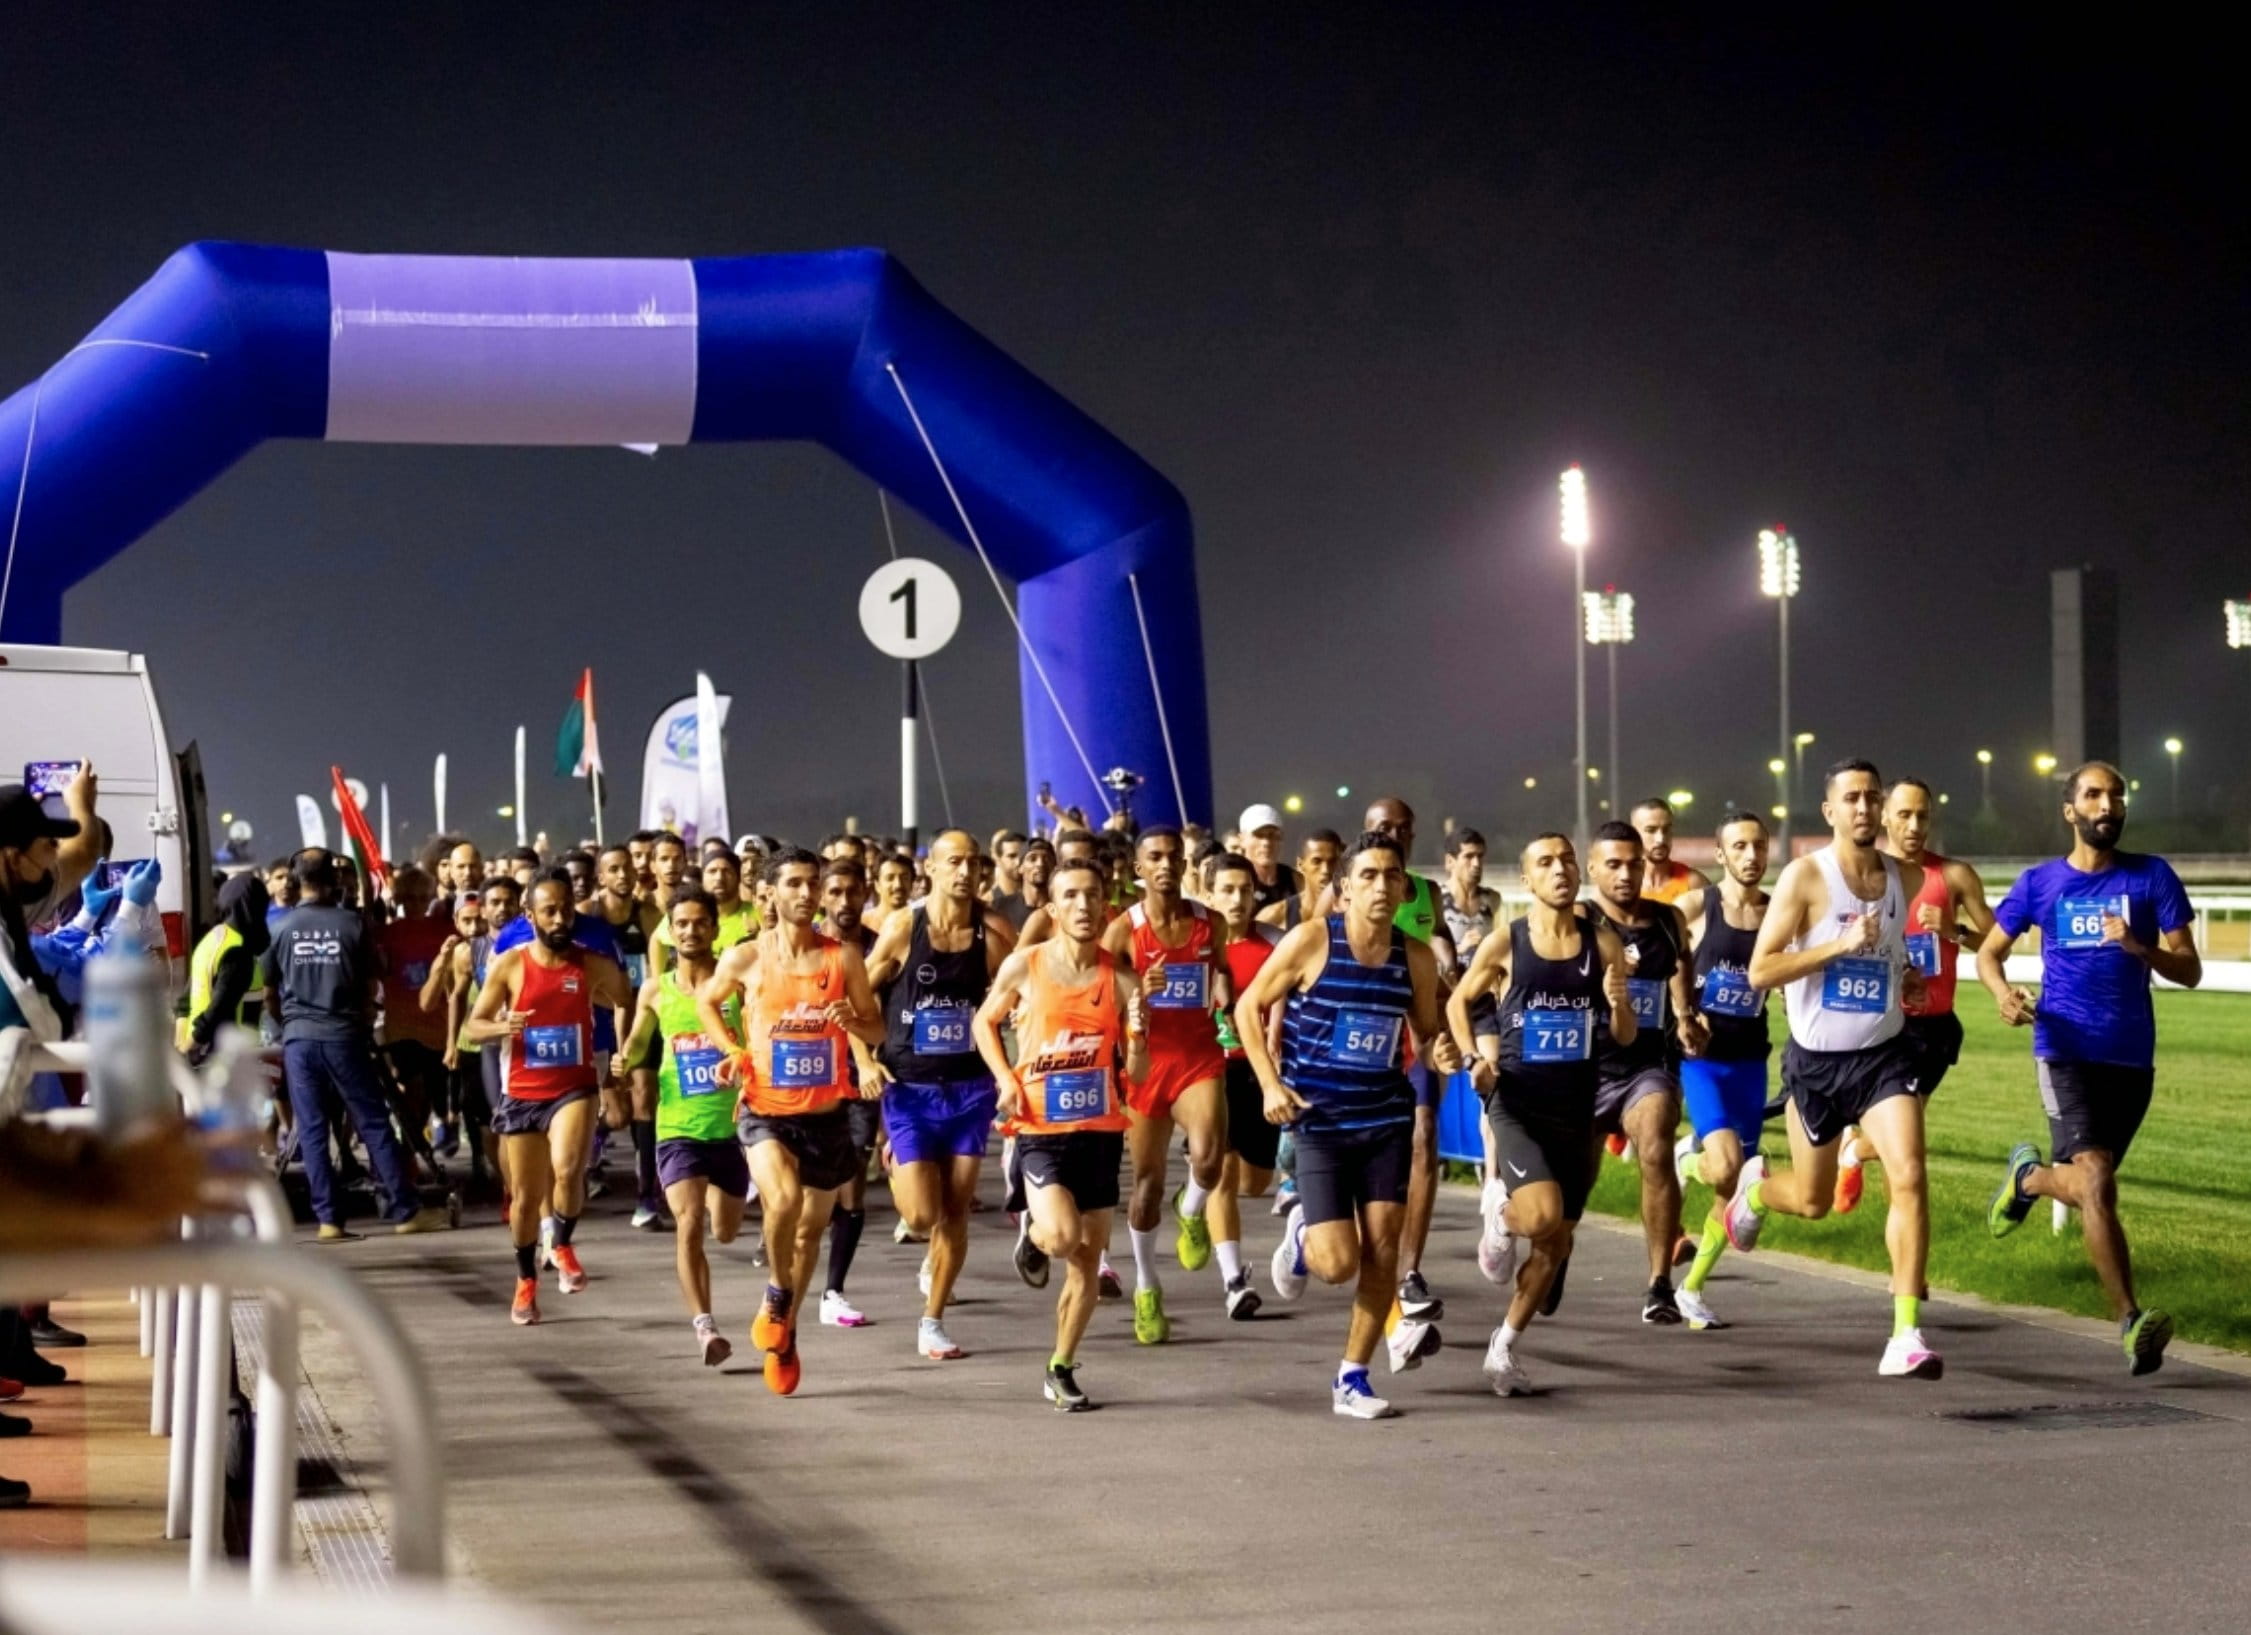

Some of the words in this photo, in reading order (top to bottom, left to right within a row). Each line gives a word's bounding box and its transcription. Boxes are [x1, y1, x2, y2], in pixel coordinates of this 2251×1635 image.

[889, 577, 917, 639] 1
[2070, 915, 2105, 936] 66
[1715, 987, 1755, 1007] 875
[1837, 977, 1881, 1000] 962
[1630, 997, 1654, 1015] 42
[927, 1024, 965, 1042] 943
[1345, 1030, 1388, 1053] 547
[1537, 1028, 1579, 1049] 712
[536, 1041, 570, 1058] 611
[783, 1056, 826, 1076] 589
[1058, 1087, 1099, 1110] 696
